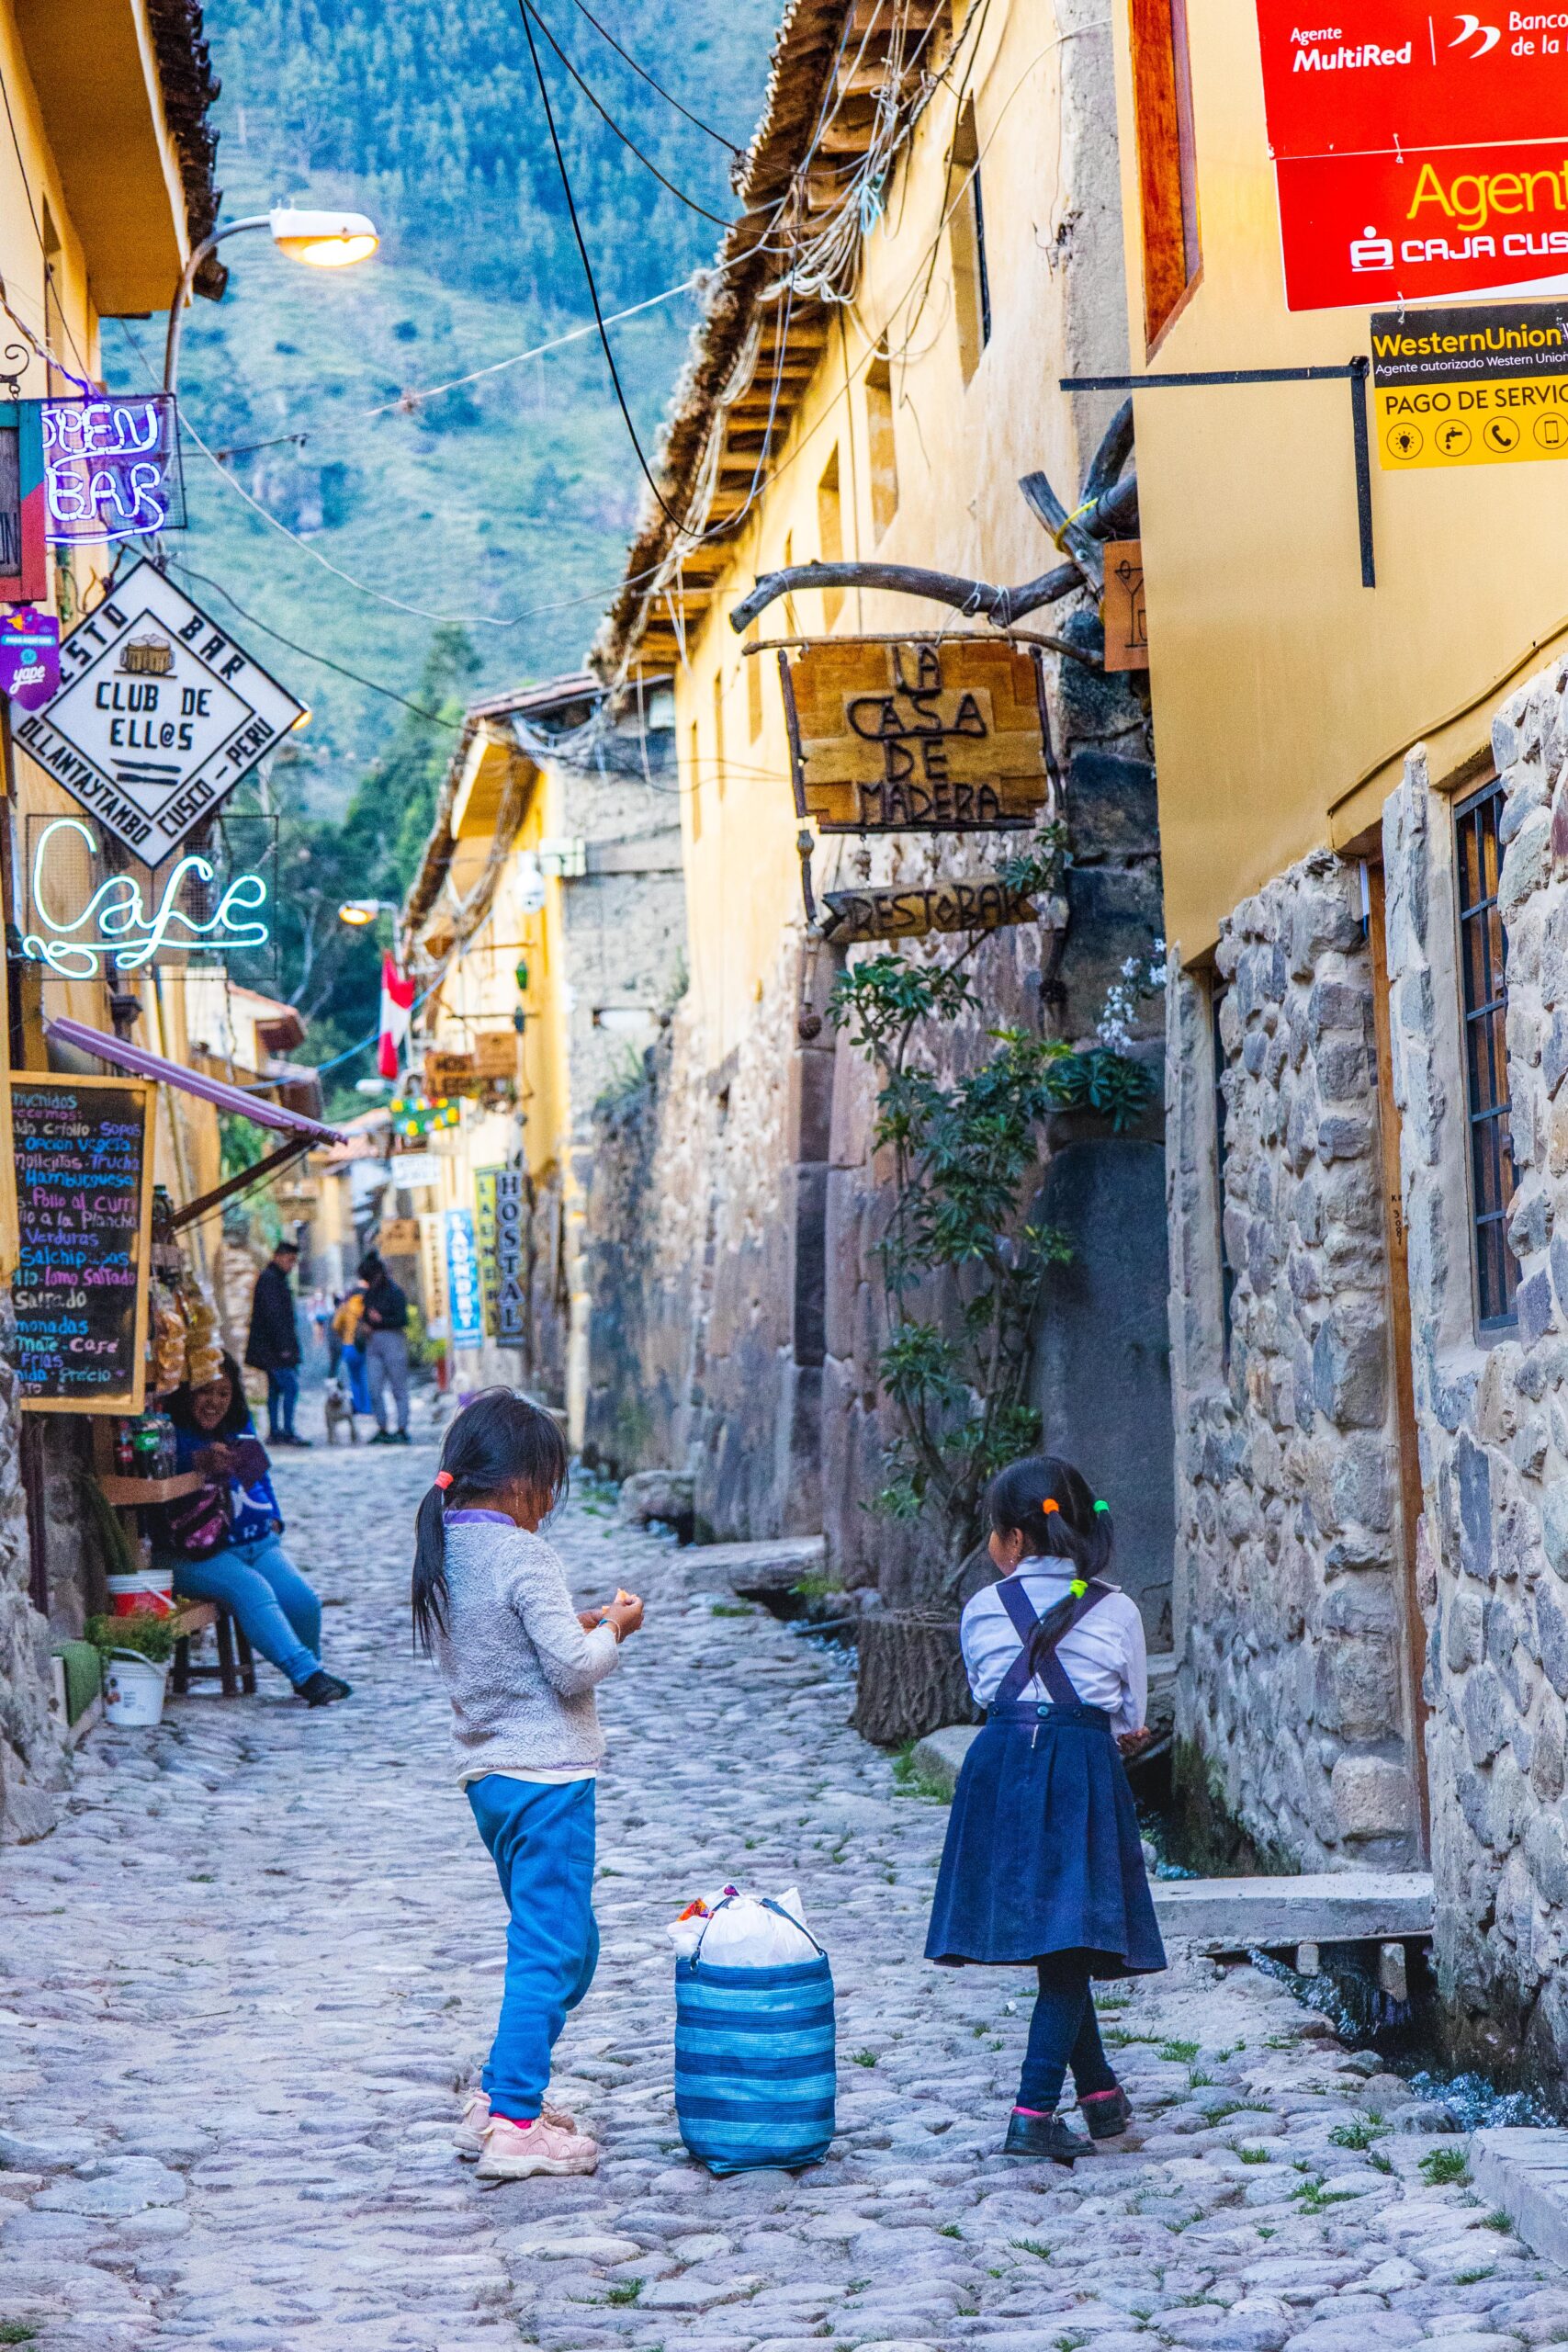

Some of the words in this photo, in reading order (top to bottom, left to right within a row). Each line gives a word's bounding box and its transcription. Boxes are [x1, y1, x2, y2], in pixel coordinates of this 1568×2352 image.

[1290, 27, 1342, 45] Agente
[1509, 10, 1568, 31] Banco
[1292, 41, 1412, 72] MultiRed
[1511, 36, 1535, 56] de
[1542, 34, 1559, 54] la
[1401, 234, 1495, 263] CAJA
[1503, 231, 1568, 256] CUS
[1375, 363, 1417, 377] Agente
[1420, 358, 1484, 372] autorizado
[1486, 355, 1533, 367] Western
[1385, 391, 1451, 415] PAGO
[1459, 389, 1489, 410] DE
[46, 462, 164, 526] BAR
[178, 615, 246, 680] BAR
[9, 665, 45, 695] yape
[892, 645, 942, 699] LA
[96, 682, 159, 711] CLUB
[181, 687, 212, 717] DE
[110, 718, 193, 751] ELL@S
[847, 694, 988, 741] CASA
[884, 736, 948, 783] DE
[17, 717, 152, 845] OLLANTAYTAMBO
[157, 778, 216, 838] CUSCO
[225, 717, 276, 768] PERU
[860, 783, 999, 826] MADERA
[501, 1175, 520, 1329] HOSTAL
